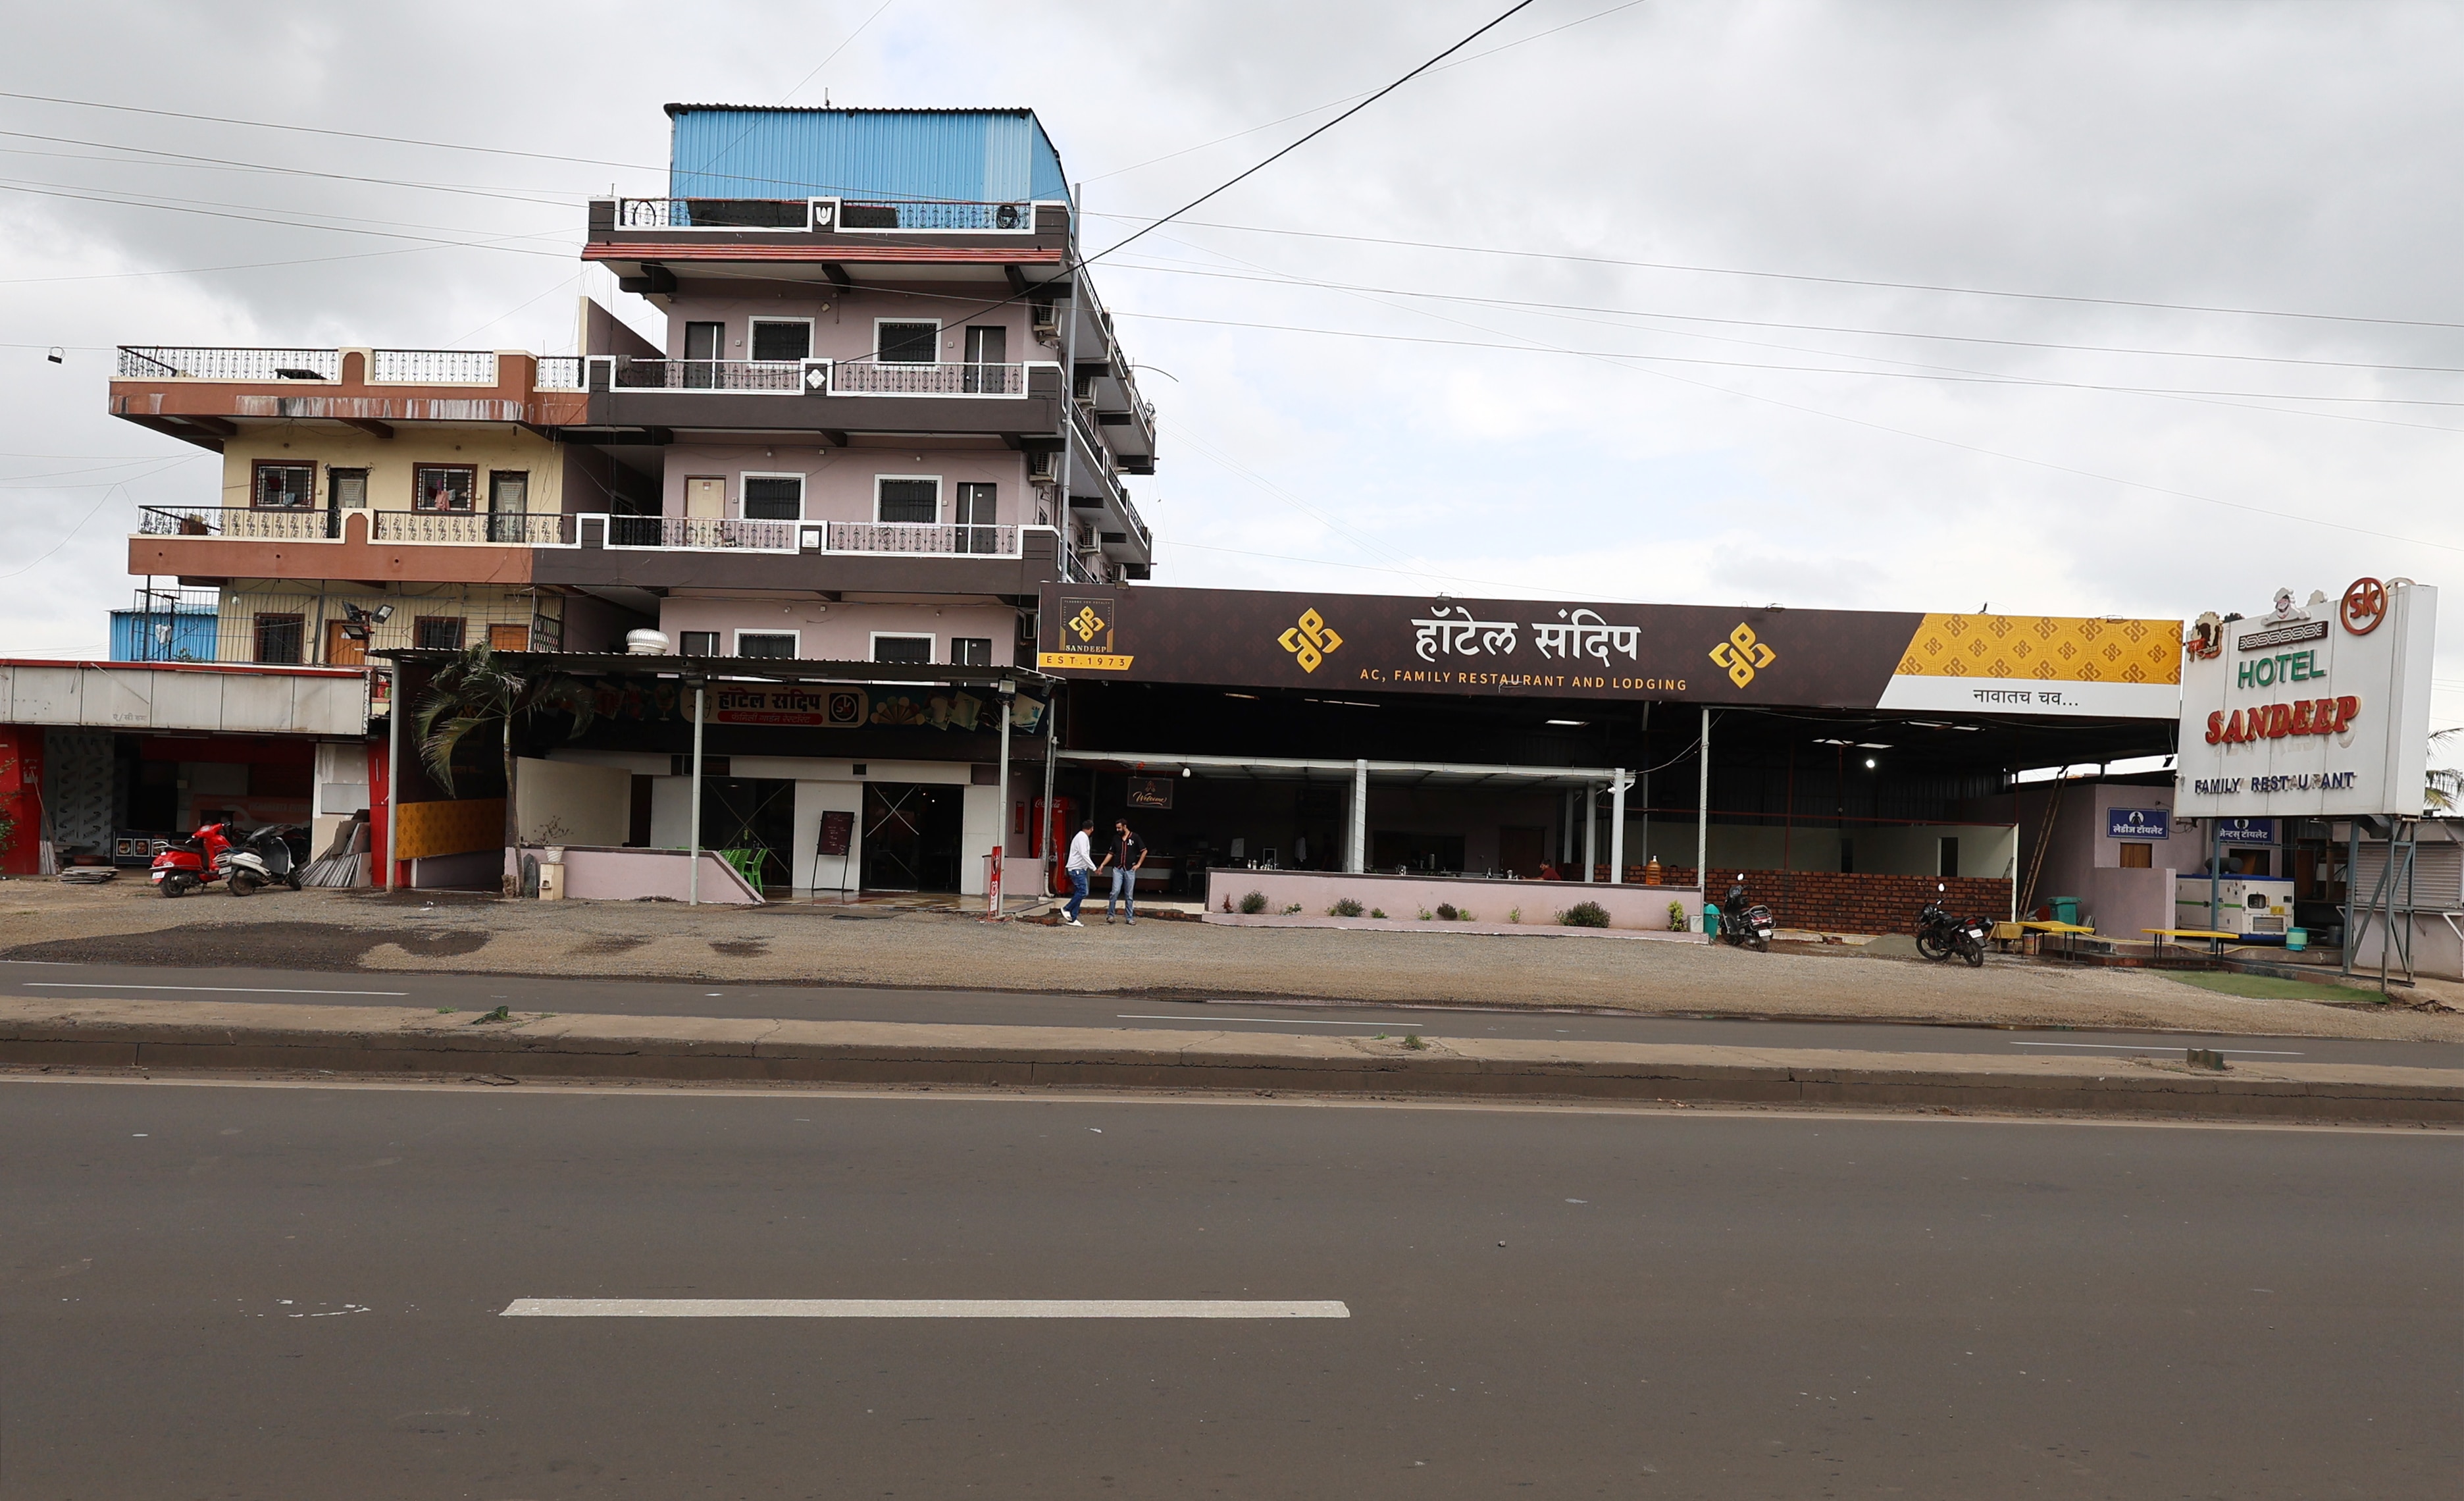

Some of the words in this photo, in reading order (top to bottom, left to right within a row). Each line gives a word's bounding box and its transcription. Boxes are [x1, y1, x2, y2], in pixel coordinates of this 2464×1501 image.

[1410, 606, 1519, 662] हॉटेल
[1531, 608, 1642, 668] संदिप
[1065, 644, 1107, 653] SANDEEP
[2238, 649, 2328, 689] HOTEL
[1360, 668, 1387, 683] AC,
[1394, 670, 1450, 683] FAMILY
[1458, 672, 1564, 687] RESTAURANT
[1572, 676, 1605, 689] AND
[1612, 677, 1687, 691] LODGING
[717, 687, 766, 710] हॉटेल
[772, 687, 821, 712] संदिप
[1972, 689, 2032, 704] नावातच
[2205, 695, 2361, 745] SANDEEP
[2195, 776, 2242, 795] FAMILY
[1133, 791, 1168, 804] Welcome
[2113, 824, 2136, 833] लेडीज
[2136, 825, 2164, 835] टॉयलेट
[2241, 830, 2269, 839] टॉयलेट
